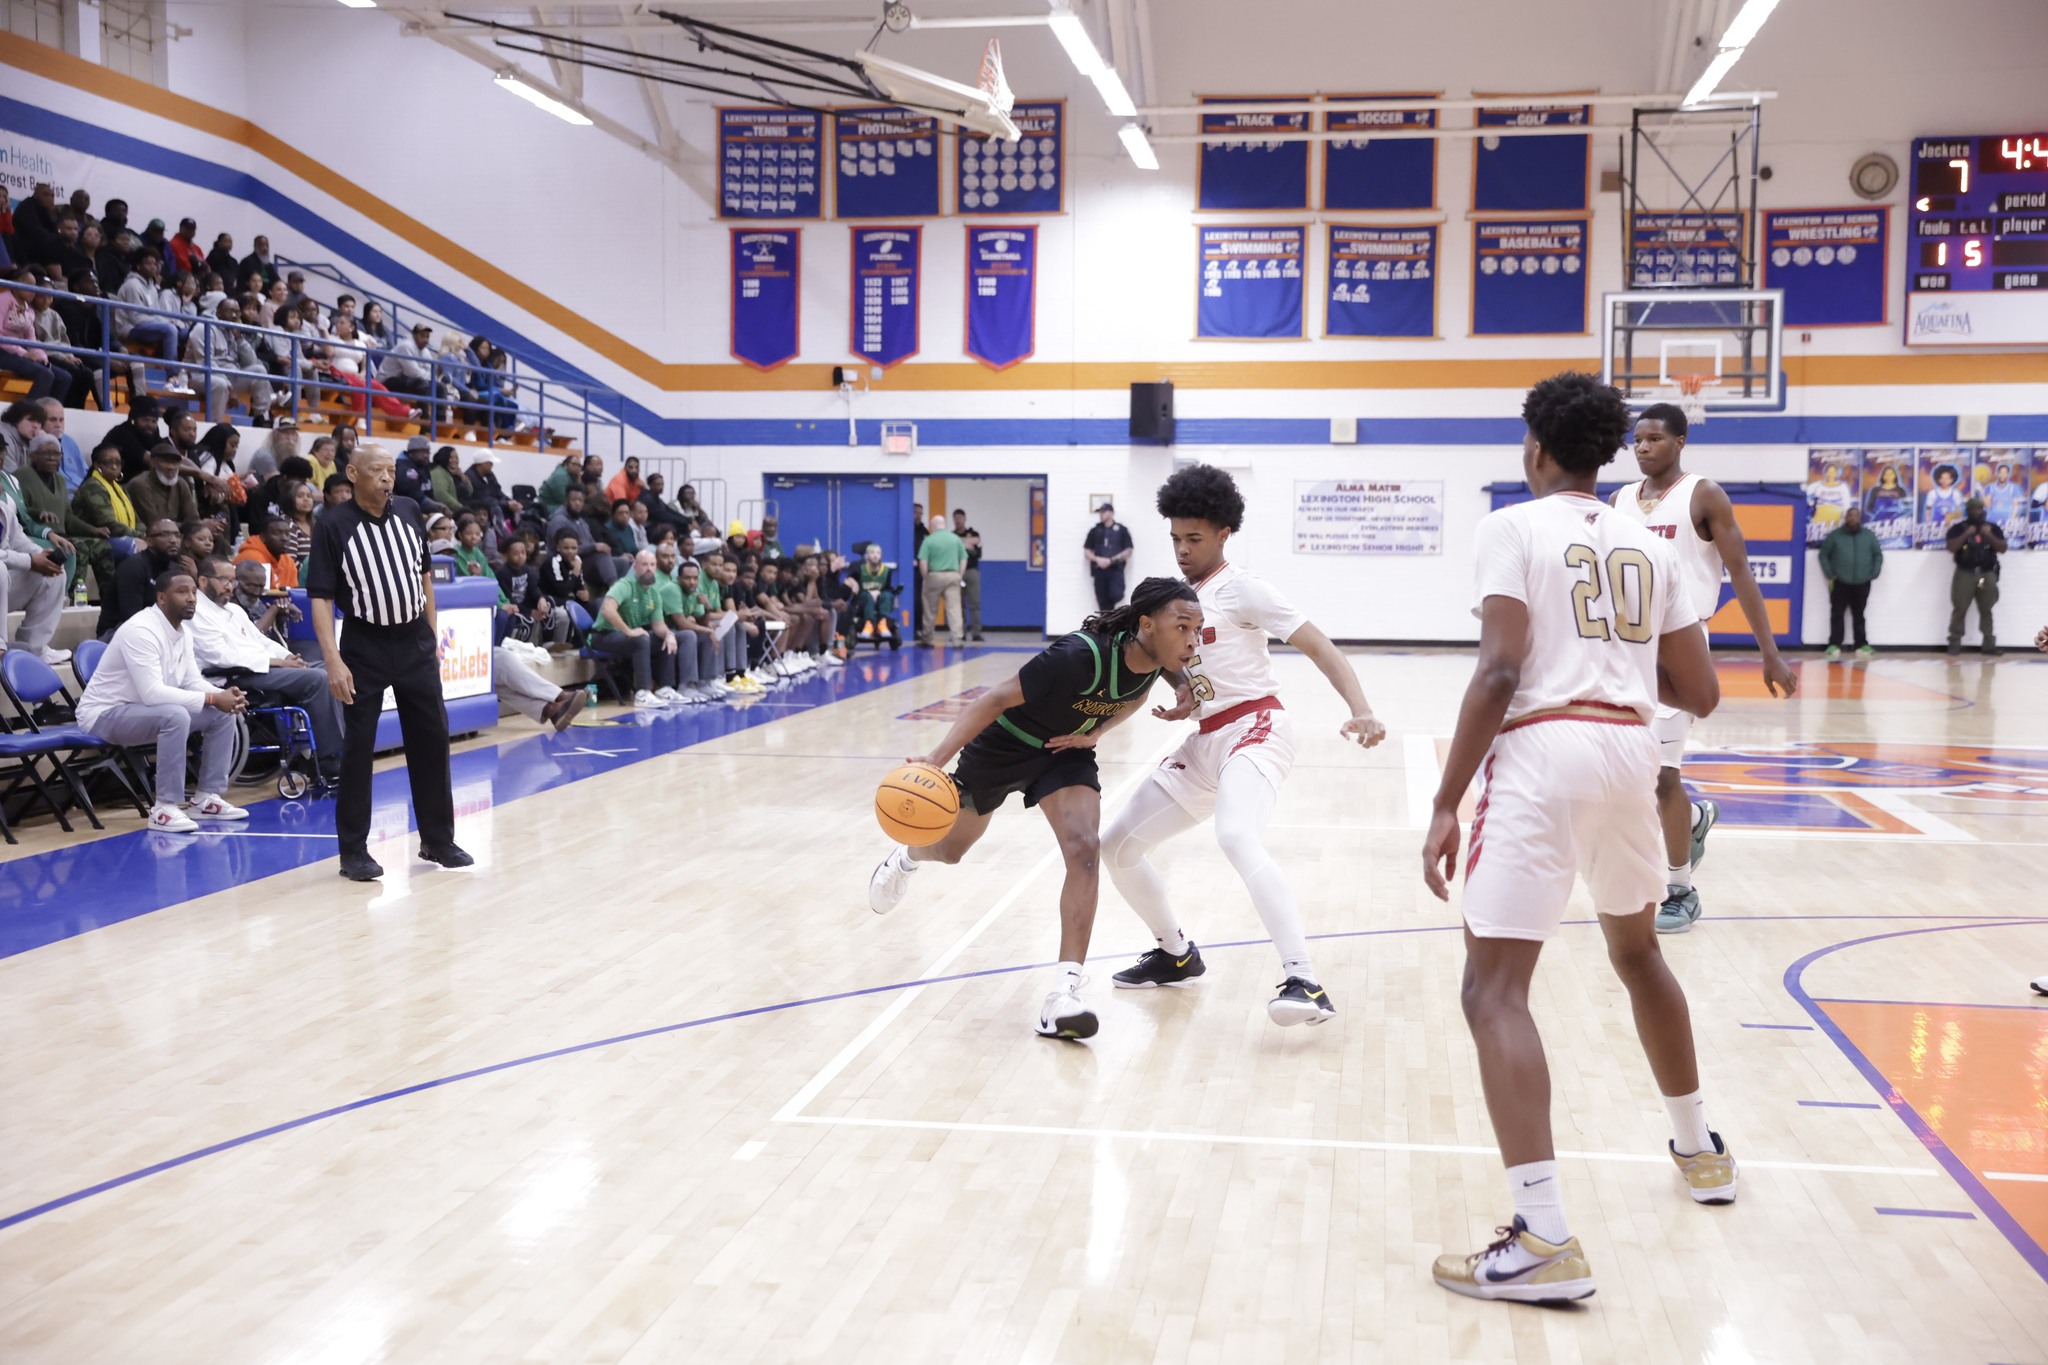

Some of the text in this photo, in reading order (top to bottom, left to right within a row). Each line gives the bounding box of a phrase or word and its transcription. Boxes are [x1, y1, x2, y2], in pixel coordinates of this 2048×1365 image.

[1236, 114, 1274, 126] TRACK
[1357, 111, 1404, 124] SOCCER
[1516, 113, 1548, 127] GOLF
[753, 126, 788, 137] TENNIS
[1918, 142, 1970, 158] Jackets
[11, 146, 53, 176] Health
[1949, 160, 1968, 193] 7
[2005, 192, 2046, 211] period
[1481, 226, 1528, 236] LEXINGTON
[1529, 225, 1549, 235] HIGH
[1788, 225, 1862, 240] WRESTLING
[1919, 220, 1951, 235] fouls
[2002, 216, 2046, 235] player
[1205, 231, 1249, 240] LEXINGTON
[1334, 230, 1379, 240] LEXINGTON
[1499, 235, 1562, 250] BASEBALL
[1667, 229, 1707, 242] TENNS
[1220, 242, 1283, 254] SWIMMING
[1350, 241, 1414, 255] SWIMMING
[1938, 242, 1946, 266] 1
[1964, 240, 1982, 267] 5
[1919, 275, 1946, 288] won
[2004, 273, 2038, 290] game
[1914, 310, 1972, 335] AQUAFINA
[1336, 484, 1401, 492] ALMA MATER
[1301, 495, 1436, 504] LEXINGTON HIGH SCHOOL
[1564, 543, 1653, 644] 20
[440, 646, 489, 683] ackets
